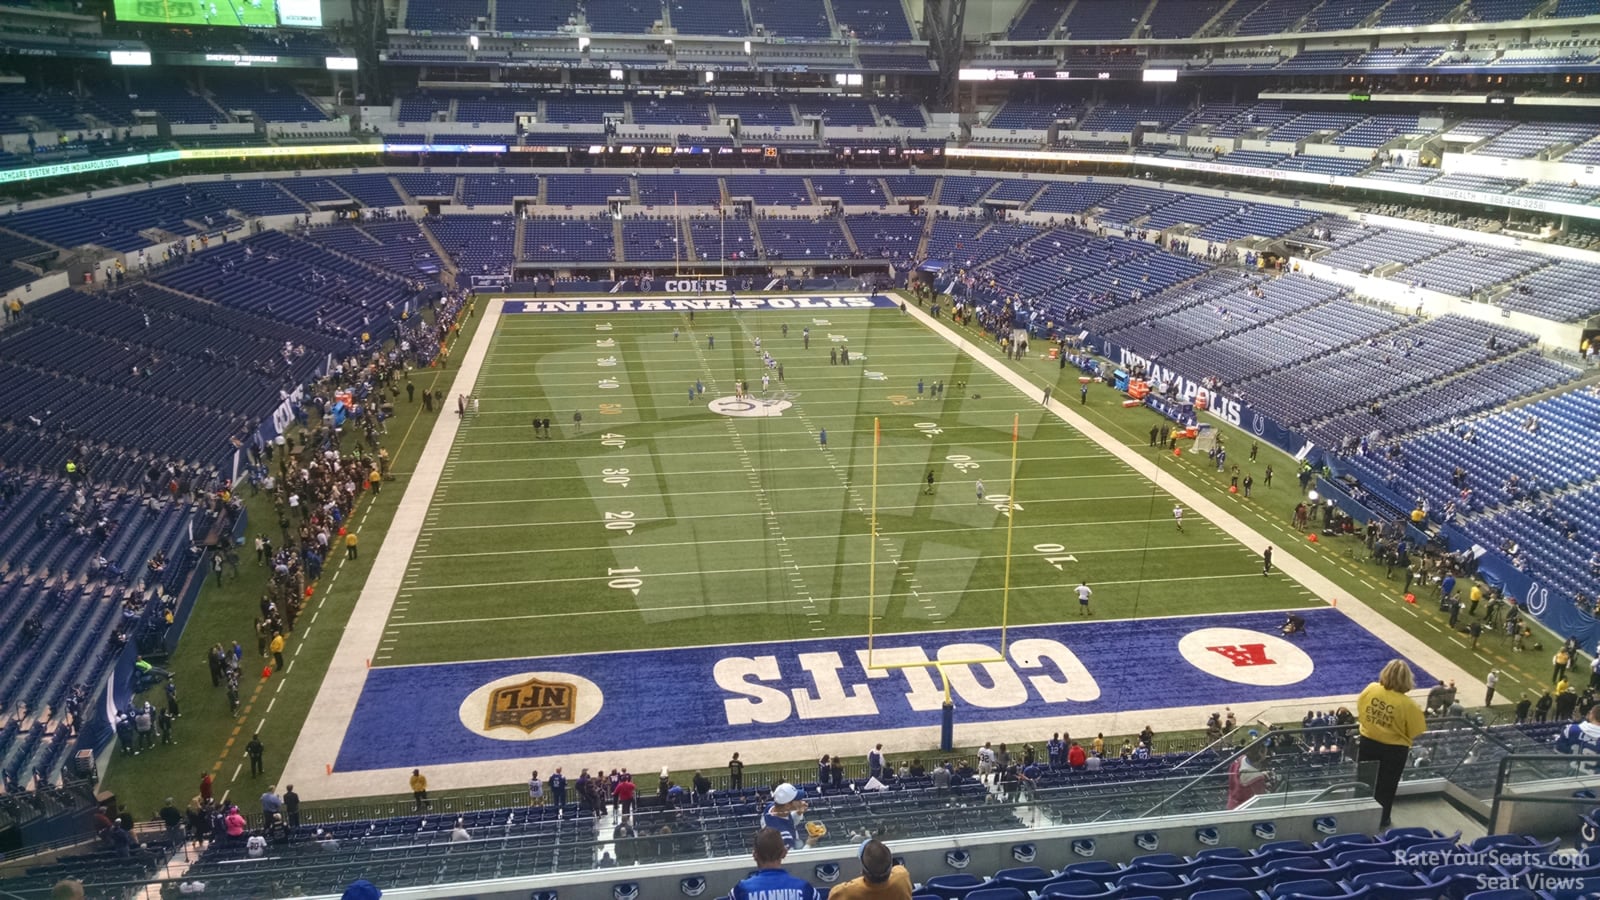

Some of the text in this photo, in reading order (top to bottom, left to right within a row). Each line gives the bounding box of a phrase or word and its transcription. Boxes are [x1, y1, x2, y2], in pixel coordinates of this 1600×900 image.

[28, 167, 50, 177] SYSTEM
[52, 166, 58, 174] OF
[60, 165, 70, 173] THE
[71, 161, 104, 172] INDIANAPOLIS
[105, 159, 120, 168] COLTS
[665, 279, 728, 292] COLTS
[522, 297, 875, 312] INDIANAPOLIS
[1120, 347, 1241, 426] INDIANAPOLIS
[913, 422, 943, 434] 40
[601, 432, 626, 446] 40
[945, 455, 980, 469] 30
[602, 468, 631, 483] 30
[605, 511, 636, 530] 20
[1033, 543, 1079, 564] 10
[608, 566, 643, 589] 10
[713, 638, 1101, 726] COLTS
[500, 686, 566, 709] NFL
[1371, 697, 1394, 714] CSC
[1366, 705, 1395, 723] EVENT
[980, 752, 990, 763] 32
[1050, 746, 1059, 755] 12
[748, 888, 803, 900] MANNING
